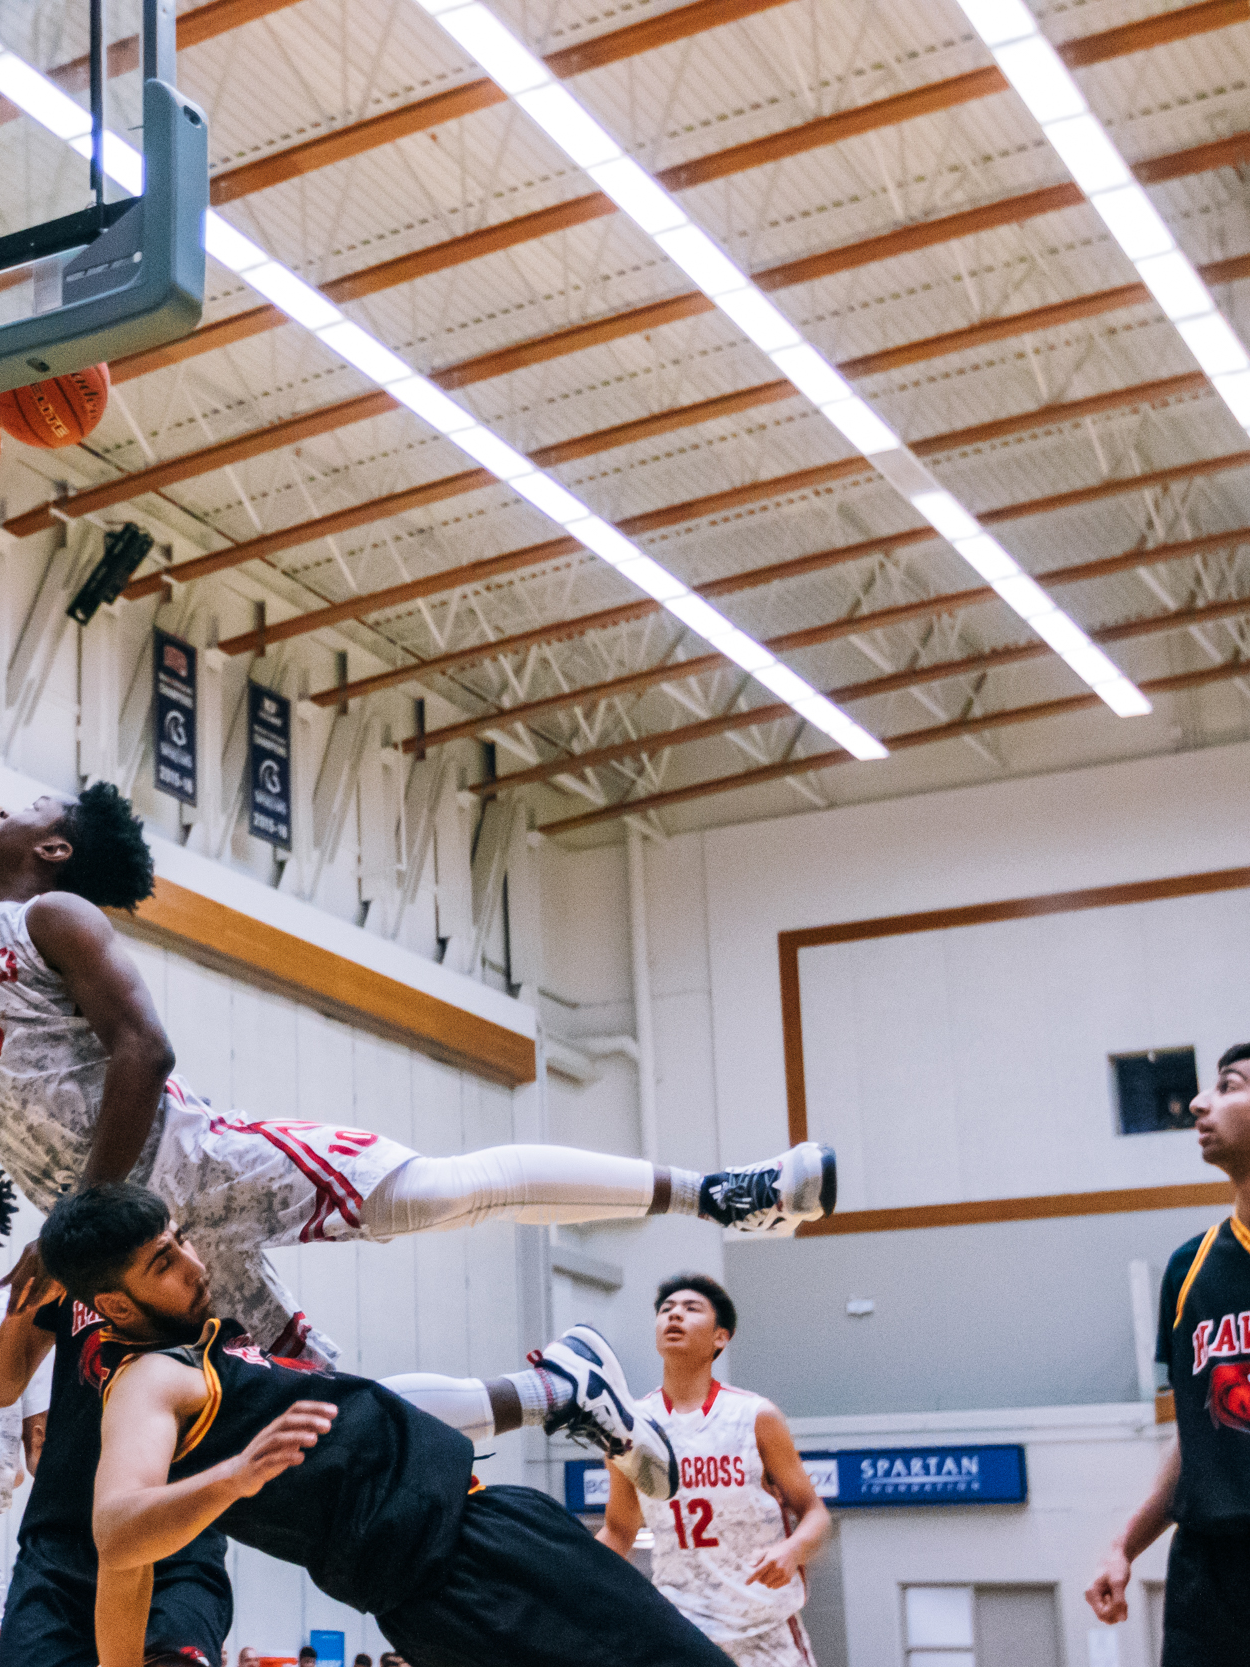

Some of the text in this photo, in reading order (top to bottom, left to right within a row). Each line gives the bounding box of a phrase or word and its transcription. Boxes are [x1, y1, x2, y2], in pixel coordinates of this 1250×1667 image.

[681, 1455, 745, 1489] CROSS
[860, 1455, 980, 1480] SPARTAN
[669, 1498, 719, 1549] 12
